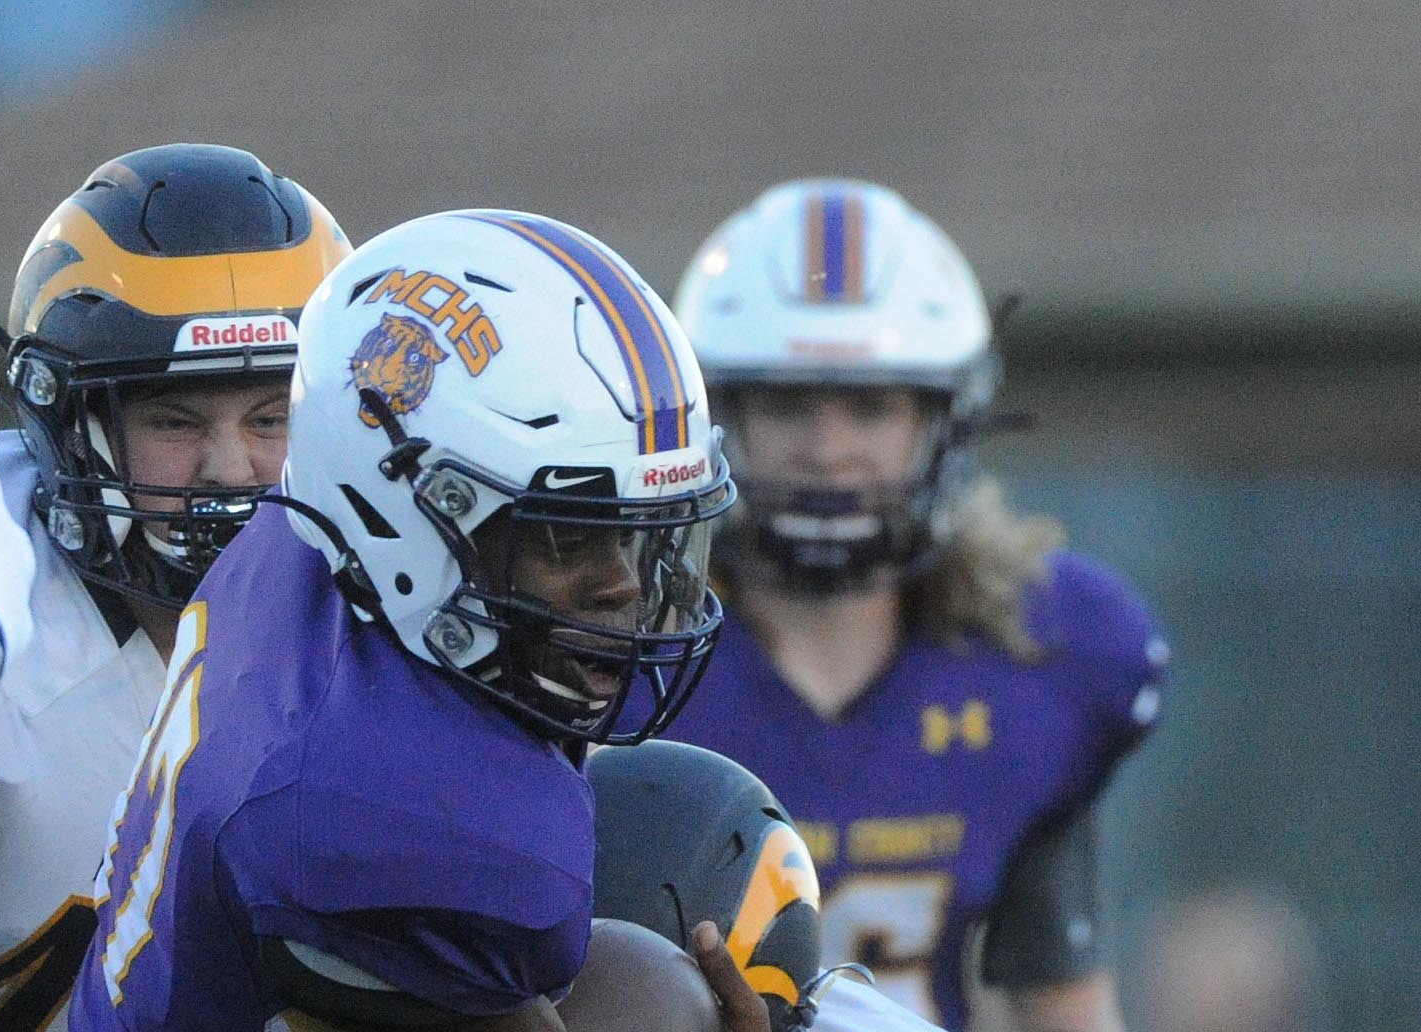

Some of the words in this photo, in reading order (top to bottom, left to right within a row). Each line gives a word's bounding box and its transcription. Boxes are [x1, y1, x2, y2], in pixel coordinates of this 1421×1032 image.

[191, 322, 287, 346] Riddell
[363, 269, 503, 378] MCHS
[643, 459, 705, 487] Riddell
